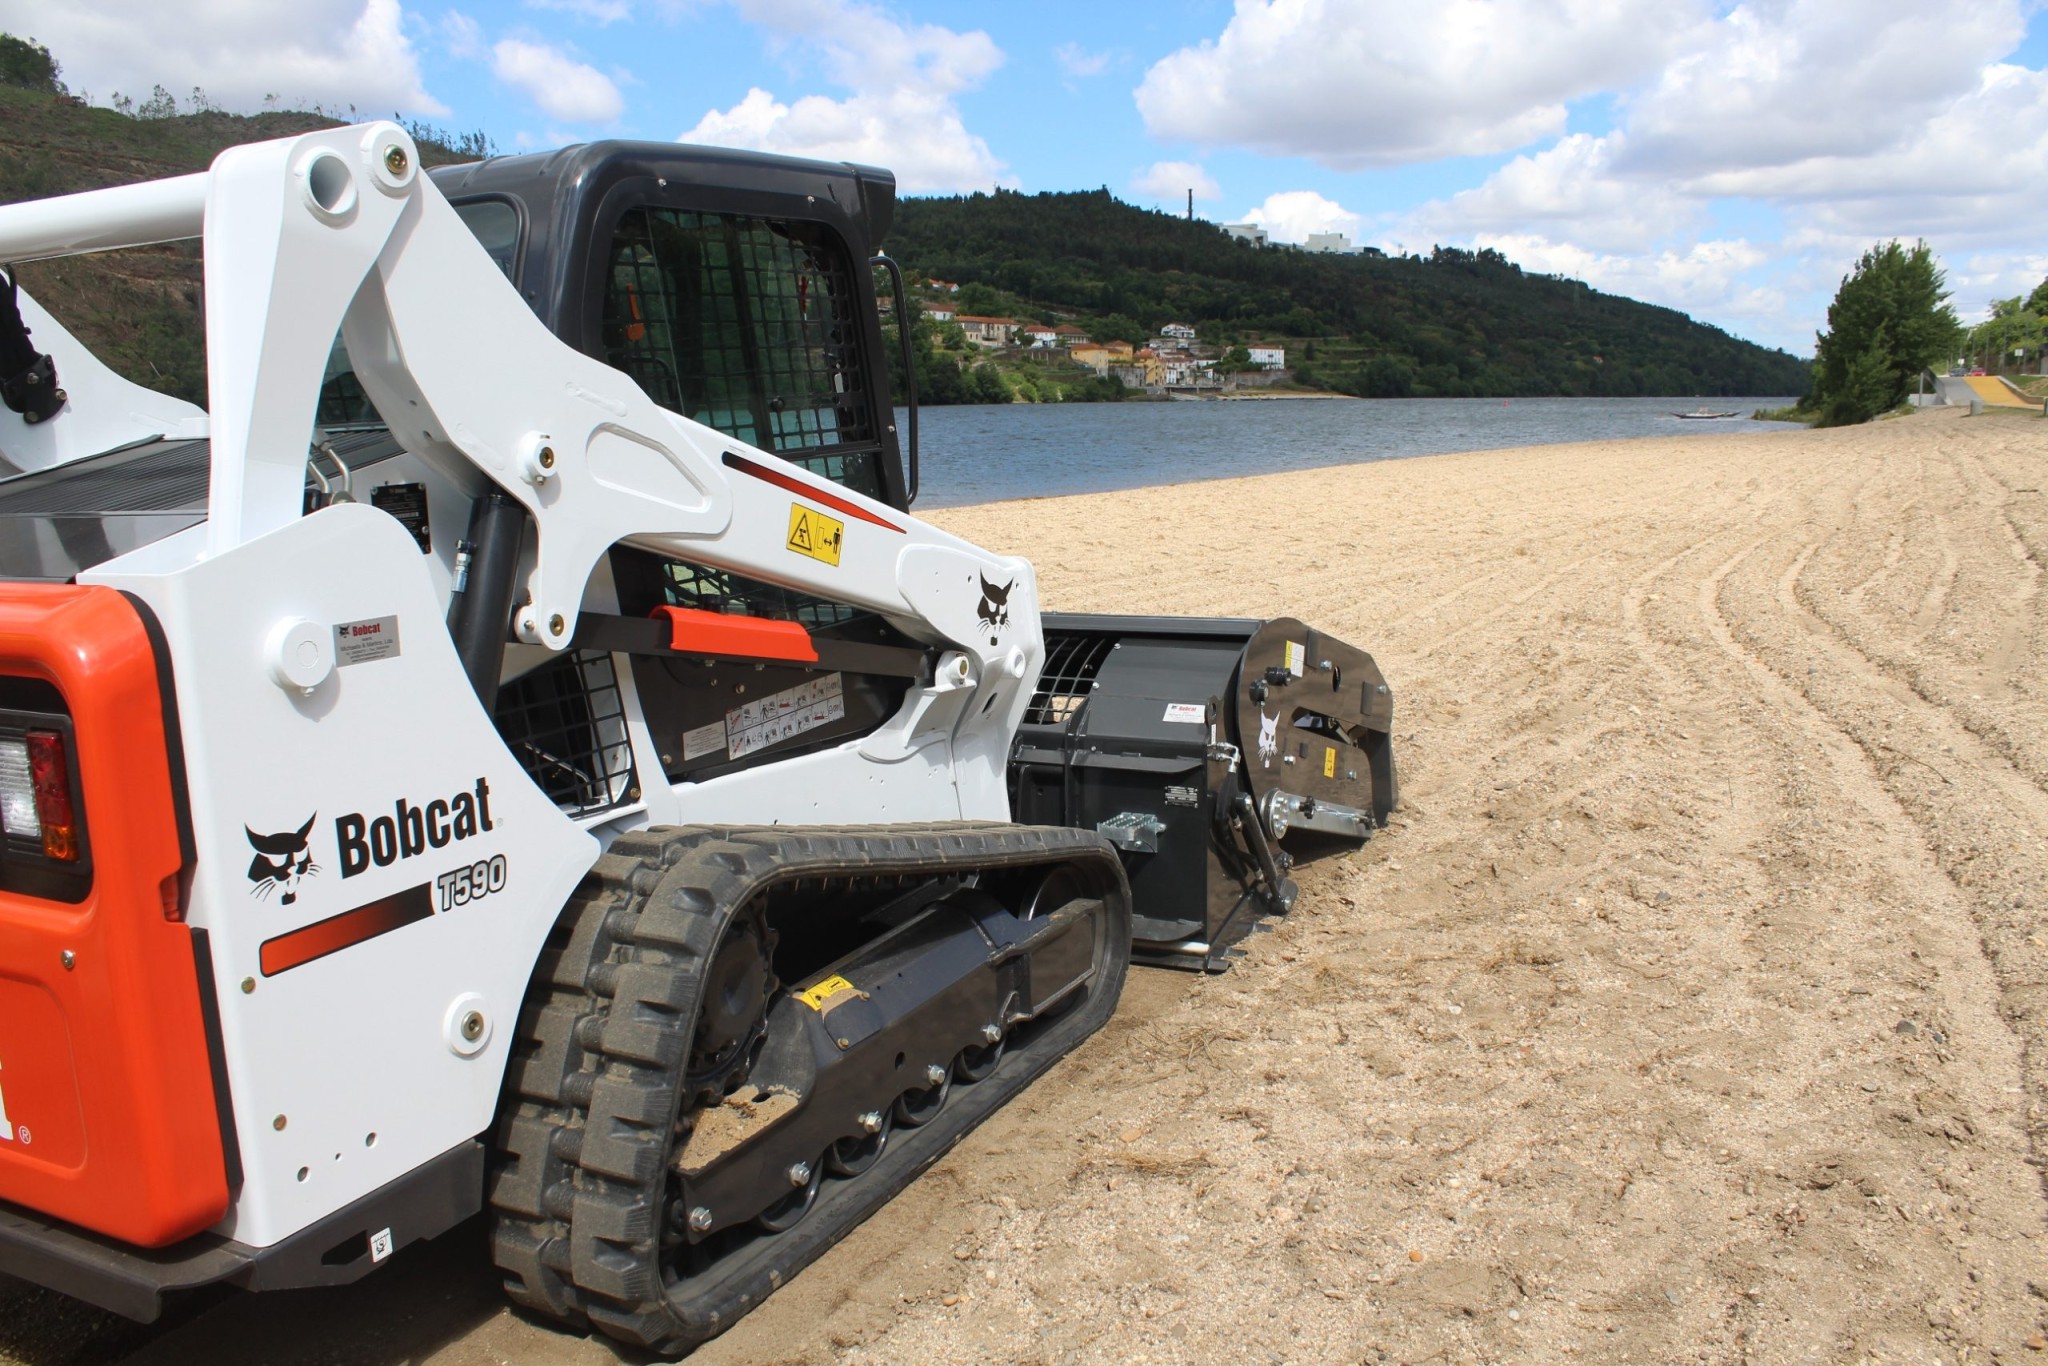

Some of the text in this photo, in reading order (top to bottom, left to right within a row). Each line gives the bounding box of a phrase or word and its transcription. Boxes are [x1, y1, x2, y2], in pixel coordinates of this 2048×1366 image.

[352, 623, 381, 637] Bobcat
[335, 777, 494, 880] Bobcat
[437, 853, 507, 912] T590
